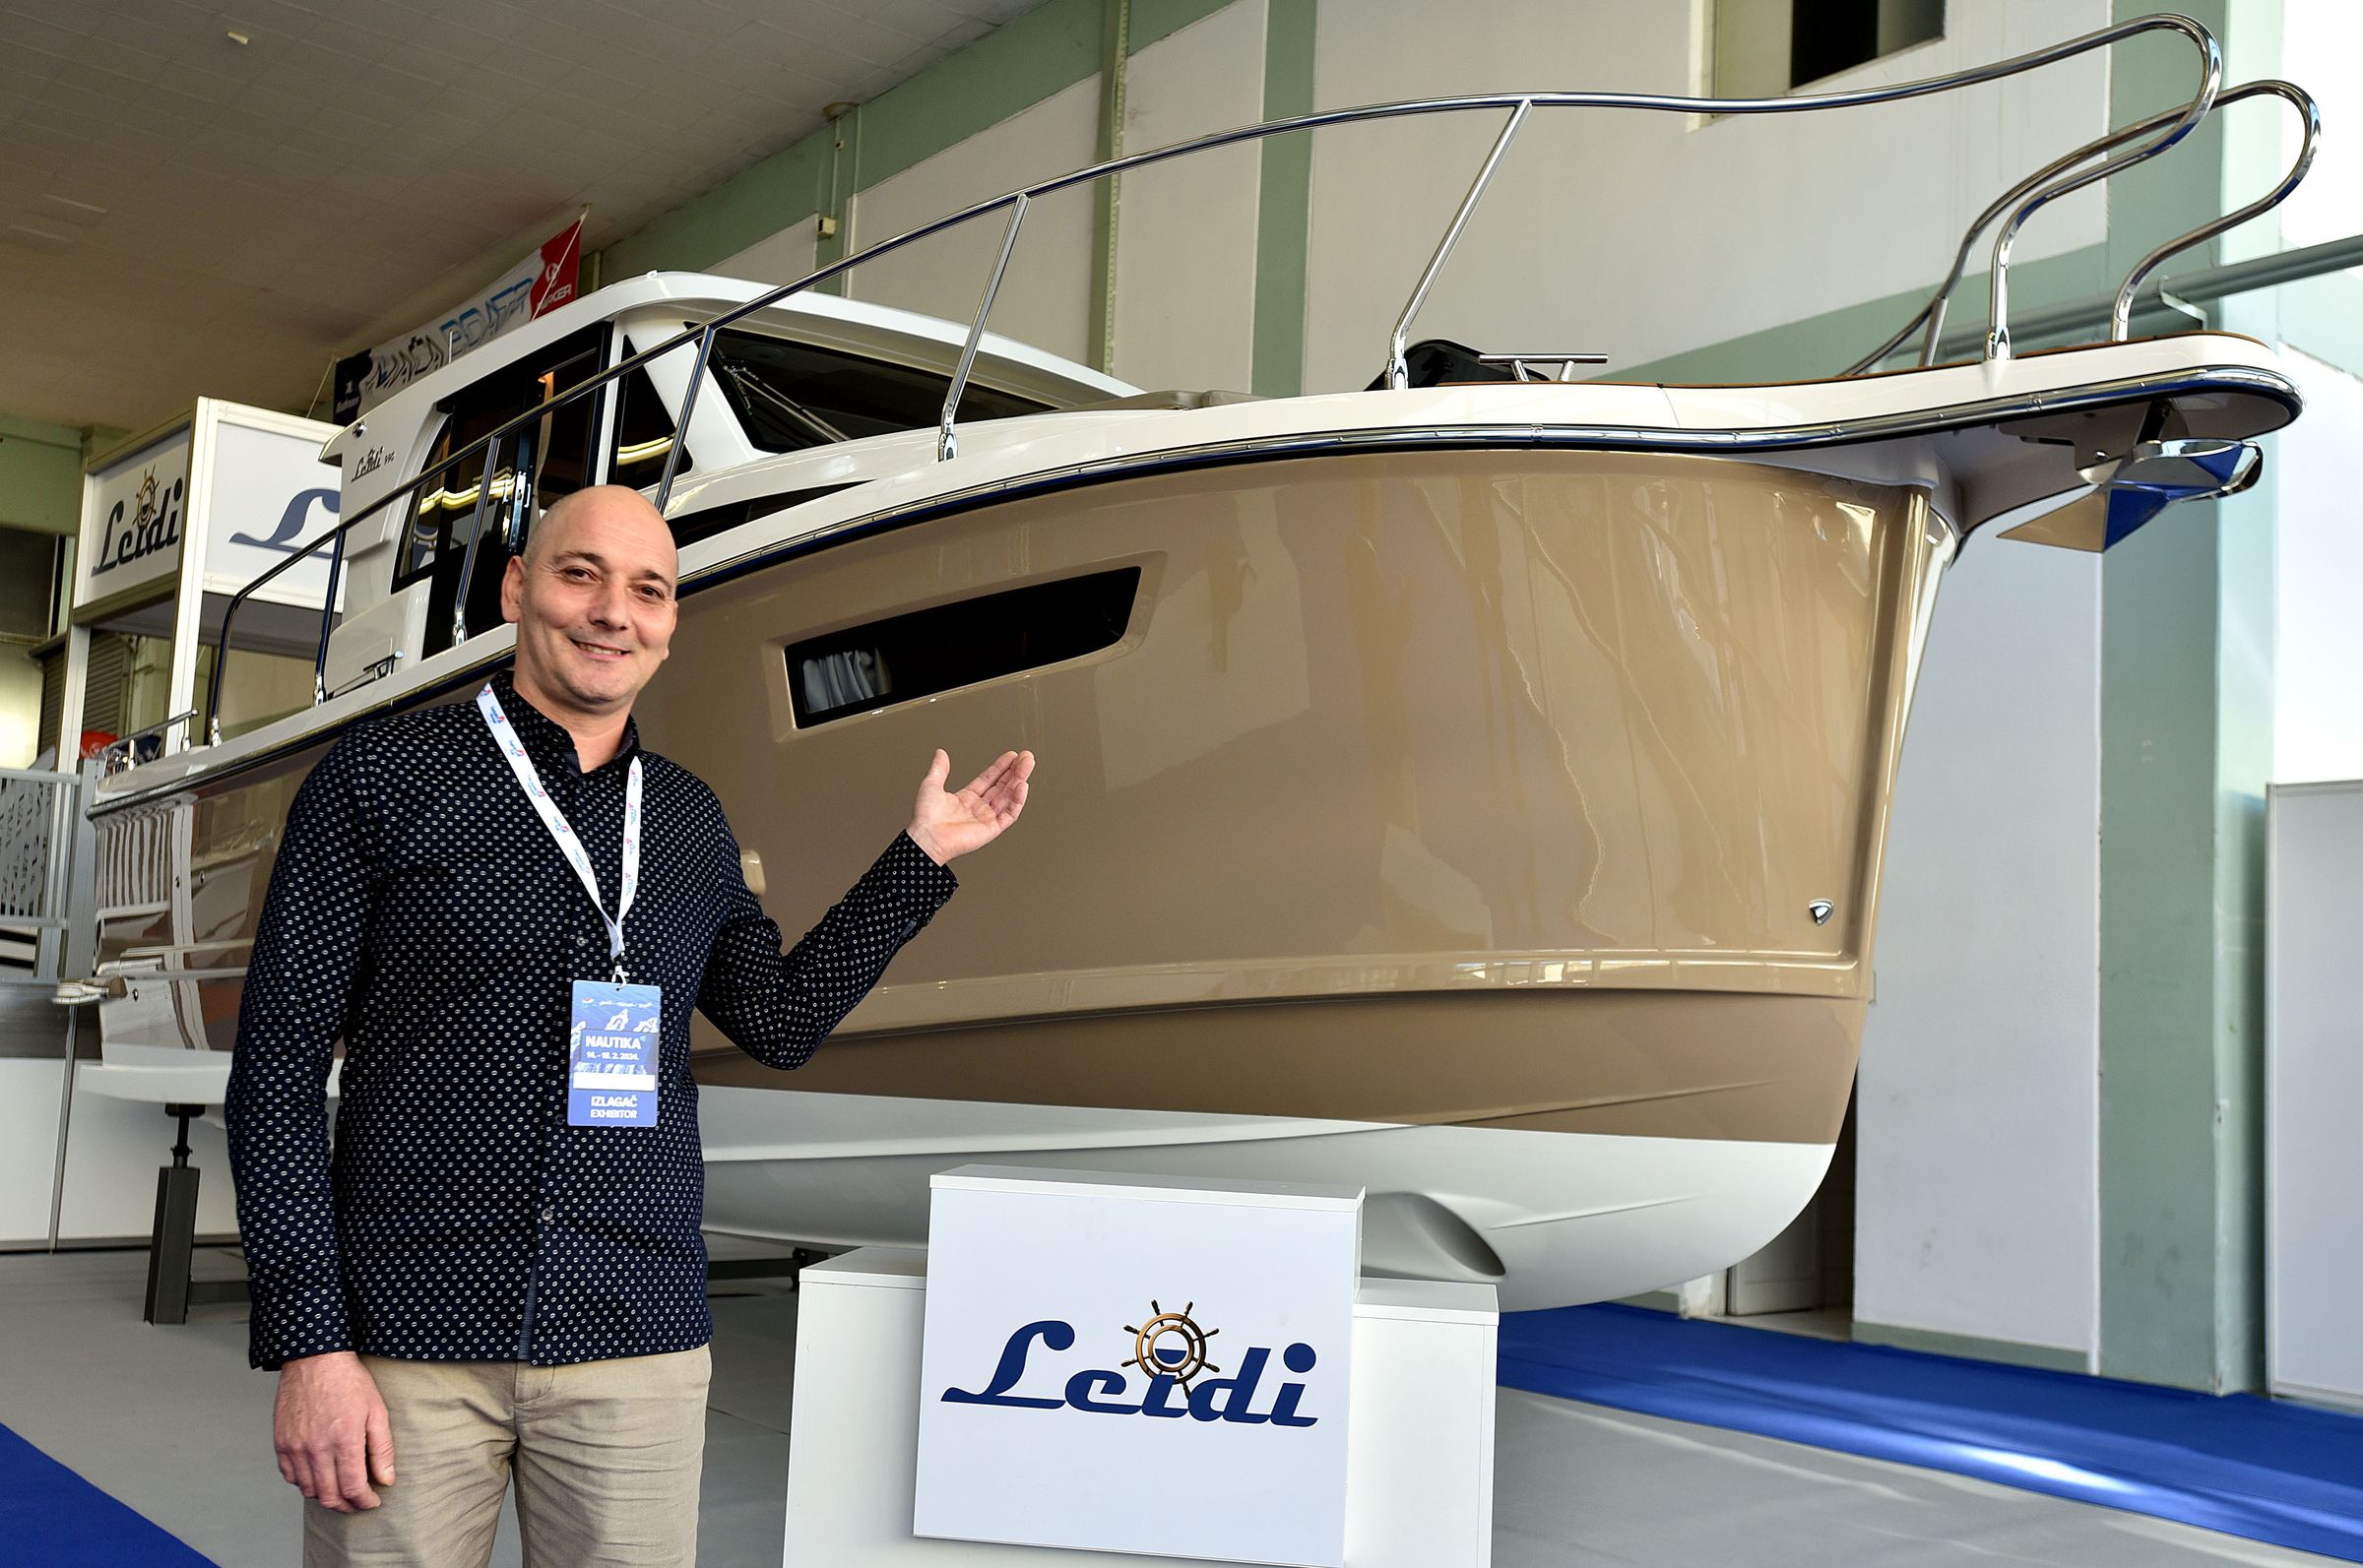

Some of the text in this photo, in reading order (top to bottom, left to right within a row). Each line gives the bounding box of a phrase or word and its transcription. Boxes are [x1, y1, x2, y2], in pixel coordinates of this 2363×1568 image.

[351, 446, 384, 483] Leidi
[91, 477, 183, 578] Leidi
[585, 1035, 642, 1050] NAUTIKA
[590, 1109, 638, 1119] EXHIBITOR
[591, 1095, 638, 1108] IZLAGAČ
[940, 1320, 1318, 1427] Leidi
